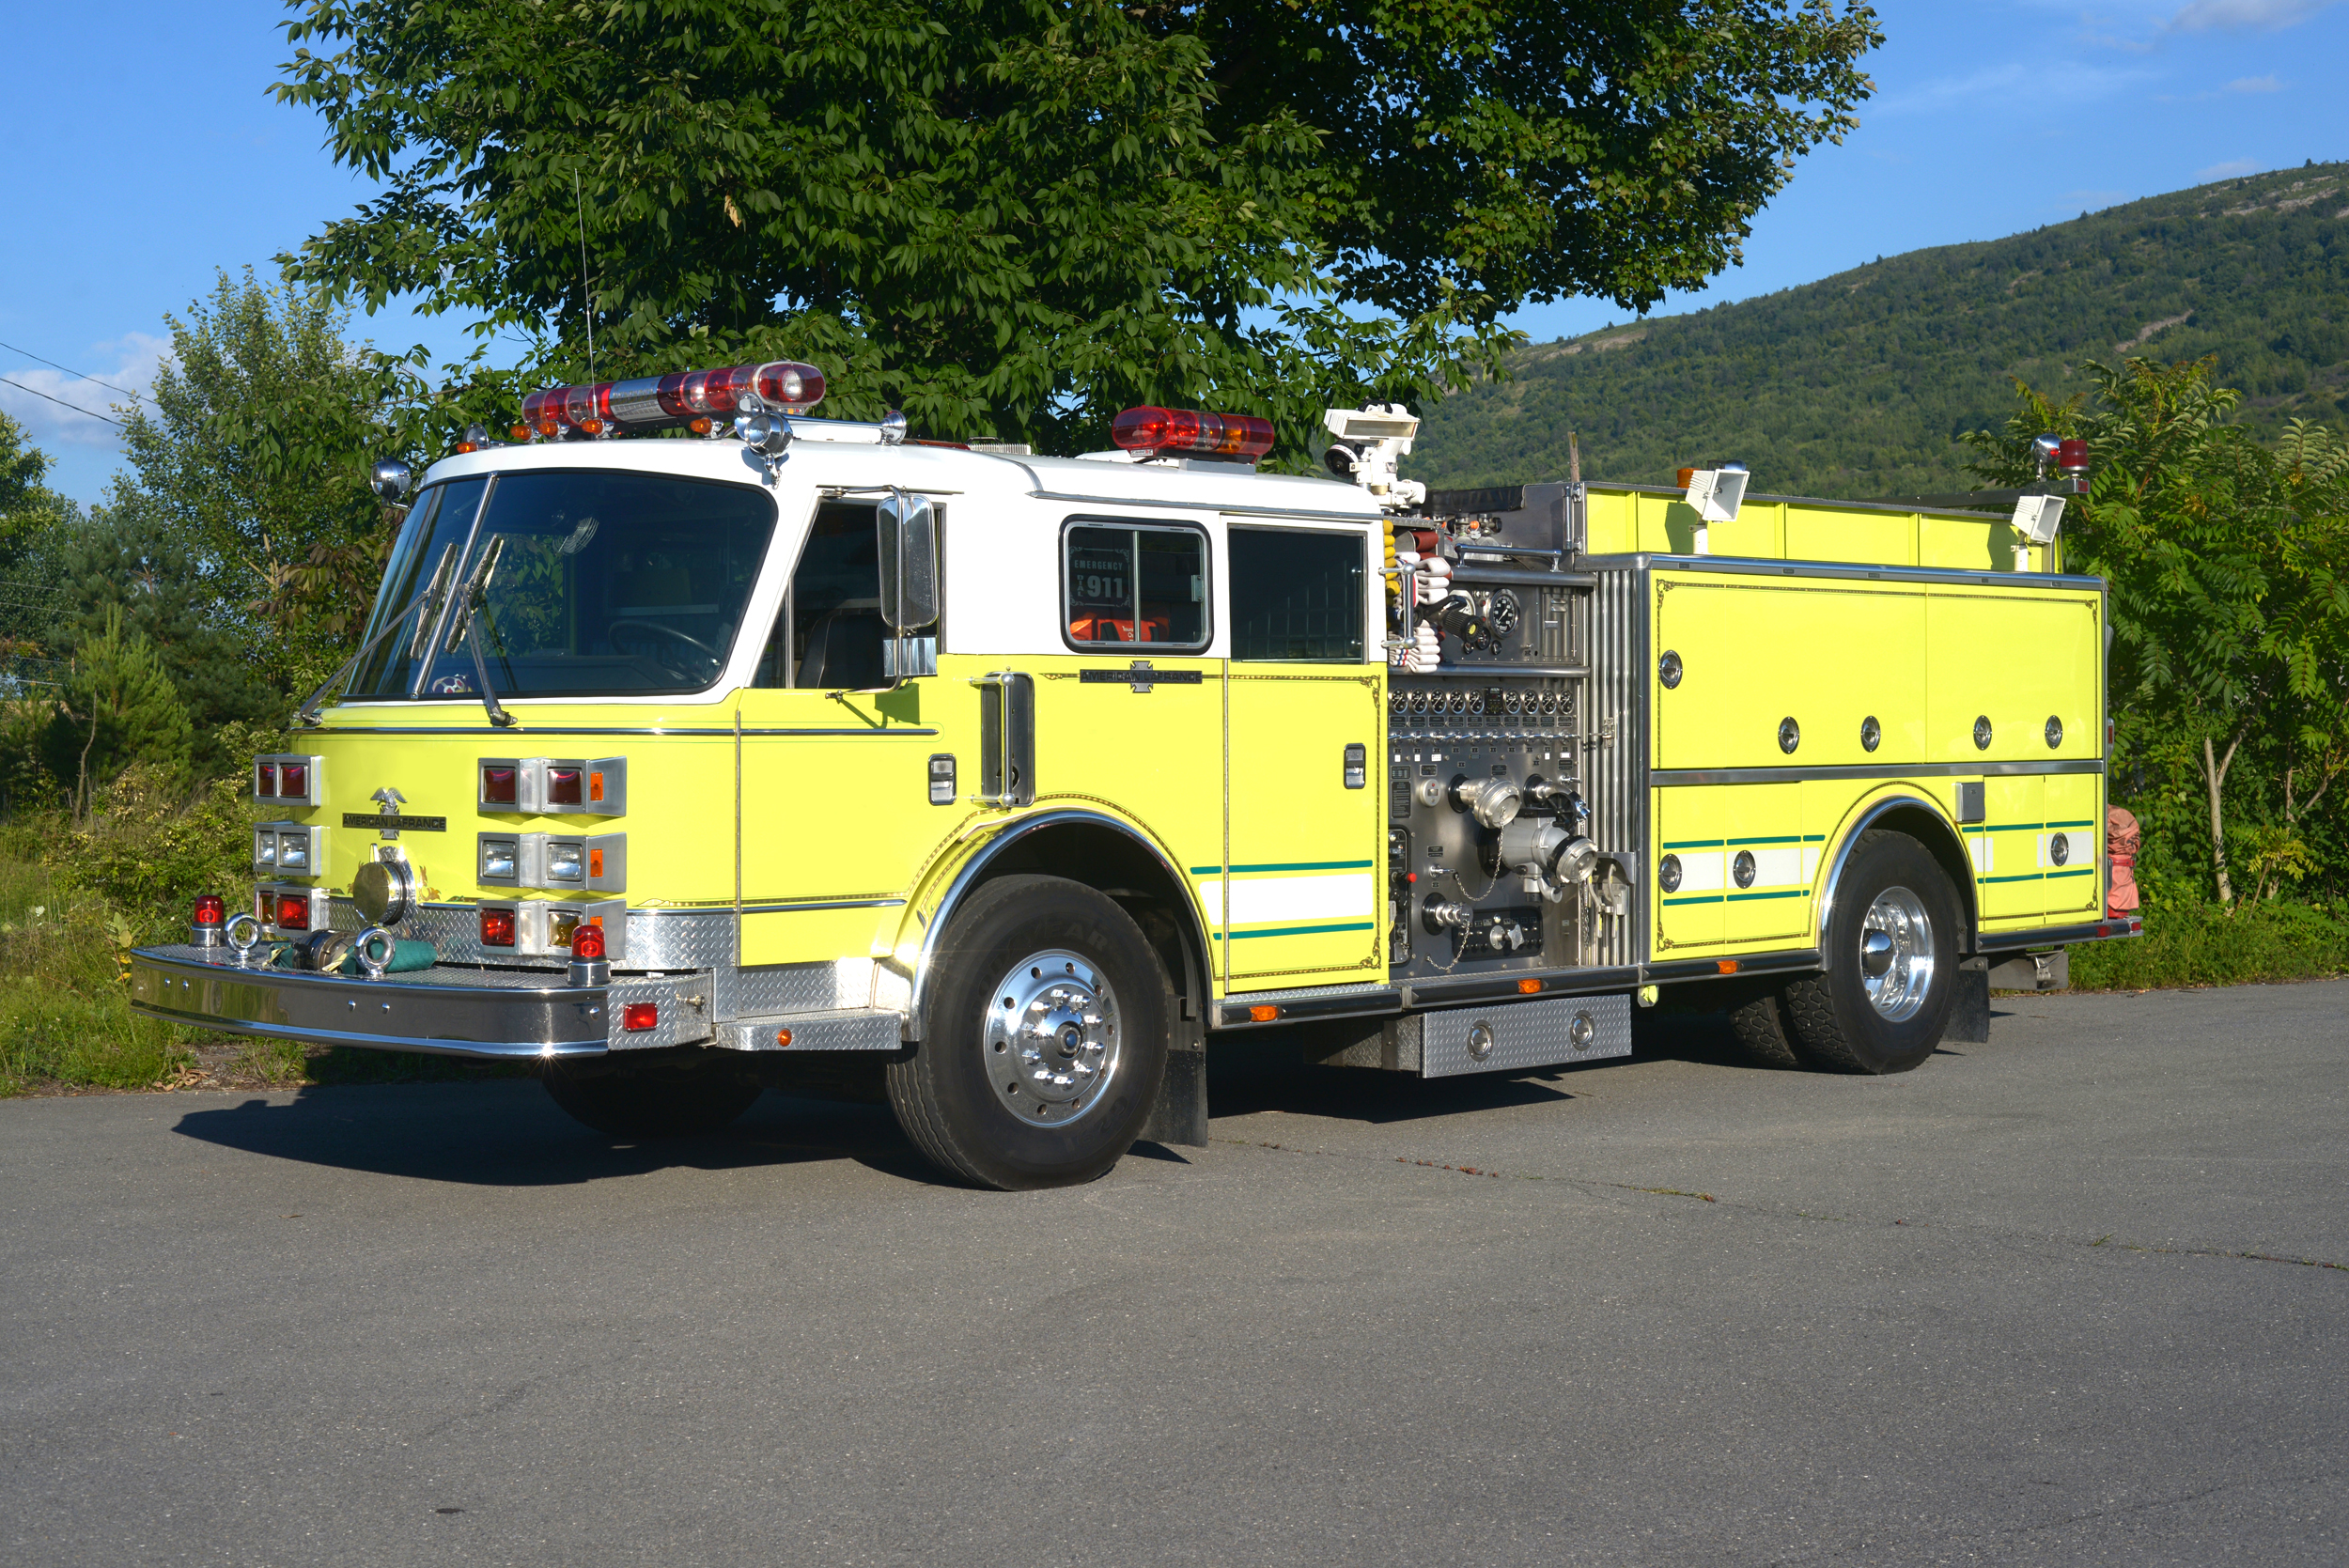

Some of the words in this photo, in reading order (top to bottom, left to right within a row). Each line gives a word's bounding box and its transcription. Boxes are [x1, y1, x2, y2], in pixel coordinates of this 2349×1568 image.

[1074, 559, 1123, 570] EMERGENCY
[1086, 575, 1123, 598] 911
[1081, 671, 1141, 682] AMERICAN
[343, 815, 388, 828] AMERICAN
